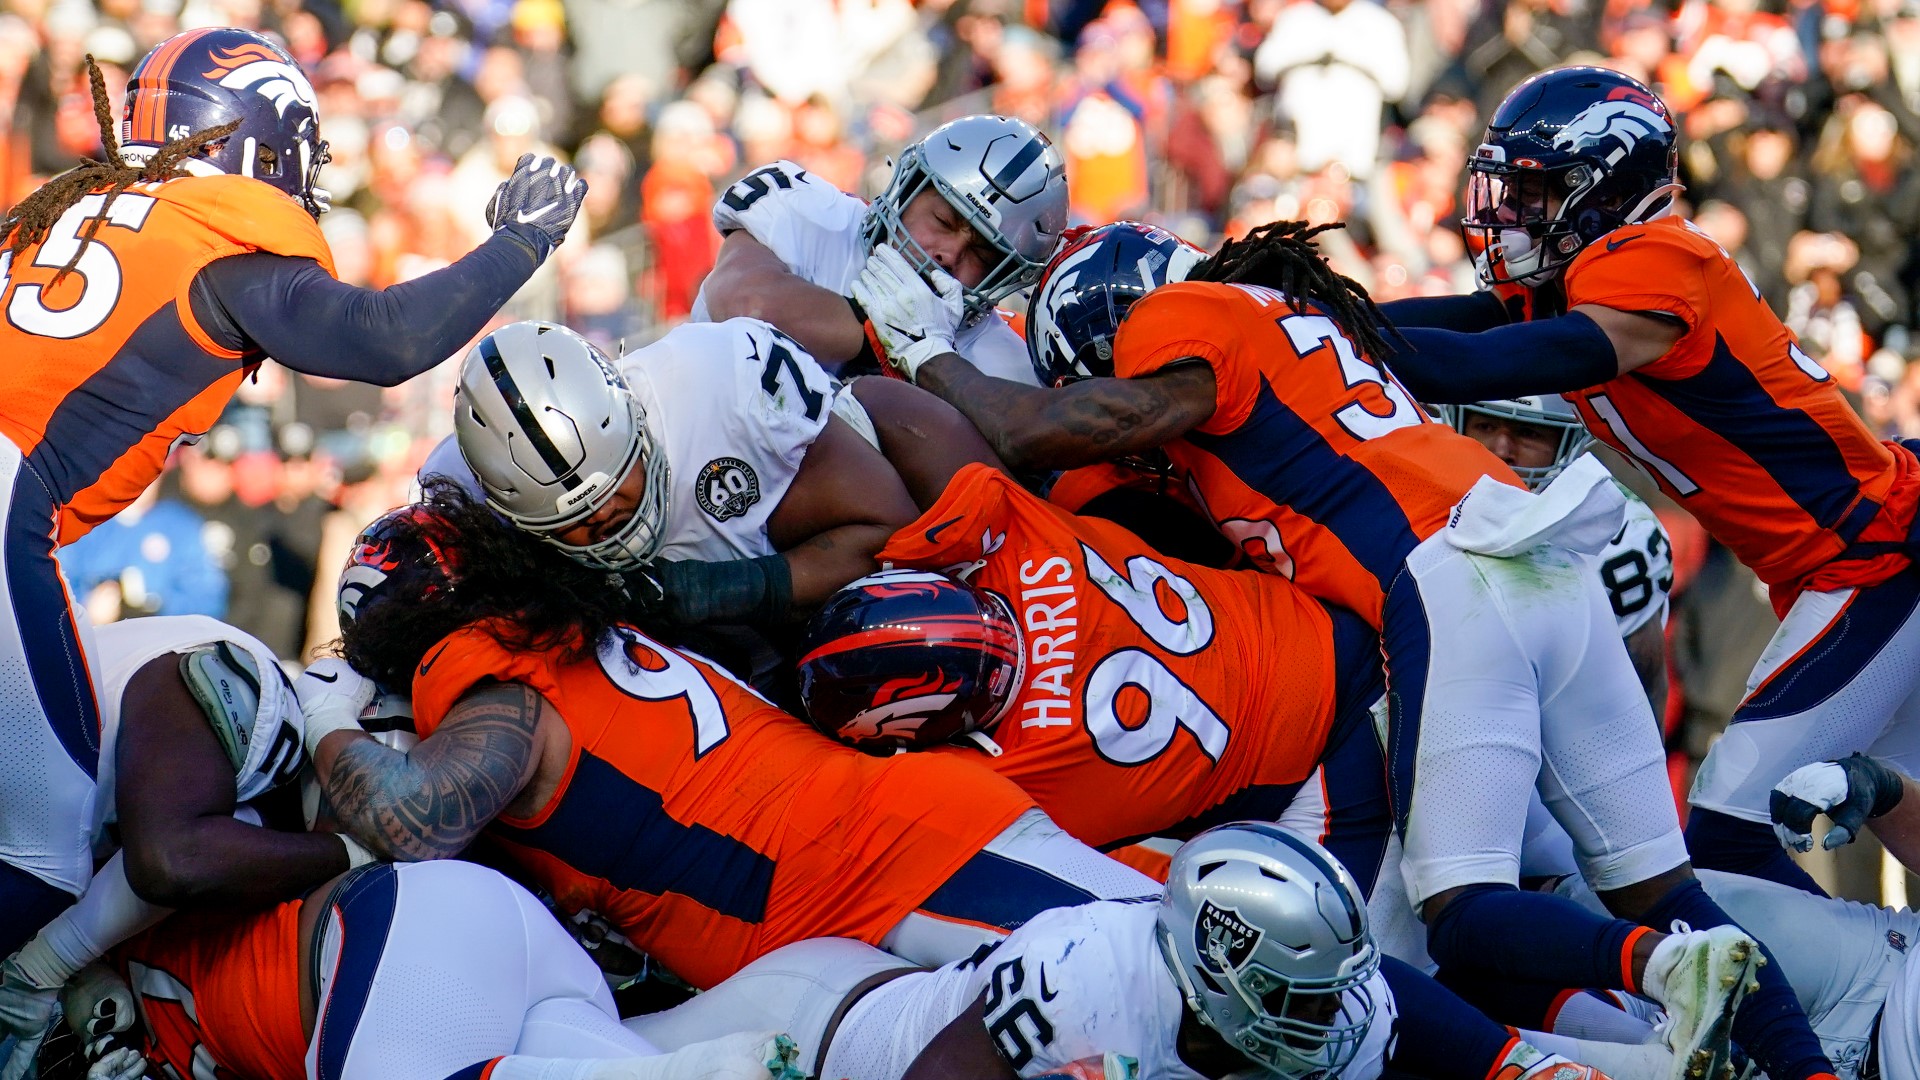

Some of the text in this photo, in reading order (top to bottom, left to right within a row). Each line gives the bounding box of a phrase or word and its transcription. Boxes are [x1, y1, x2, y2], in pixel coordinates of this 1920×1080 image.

[168, 124, 191, 141] 45
[965, 192, 993, 219] RAIDERS
[0, 192, 158, 340] 5
[761, 328, 824, 423] 7
[1276, 313, 1434, 442] 3
[567, 483, 598, 506] RAIDERS
[710, 468, 750, 507] 60
[1600, 526, 1674, 617] 83
[1019, 556, 1078, 729] HARRIS
[1078, 540, 1232, 768] 96
[594, 625, 770, 762] 9
[1206, 904, 1254, 938] RAIDERS
